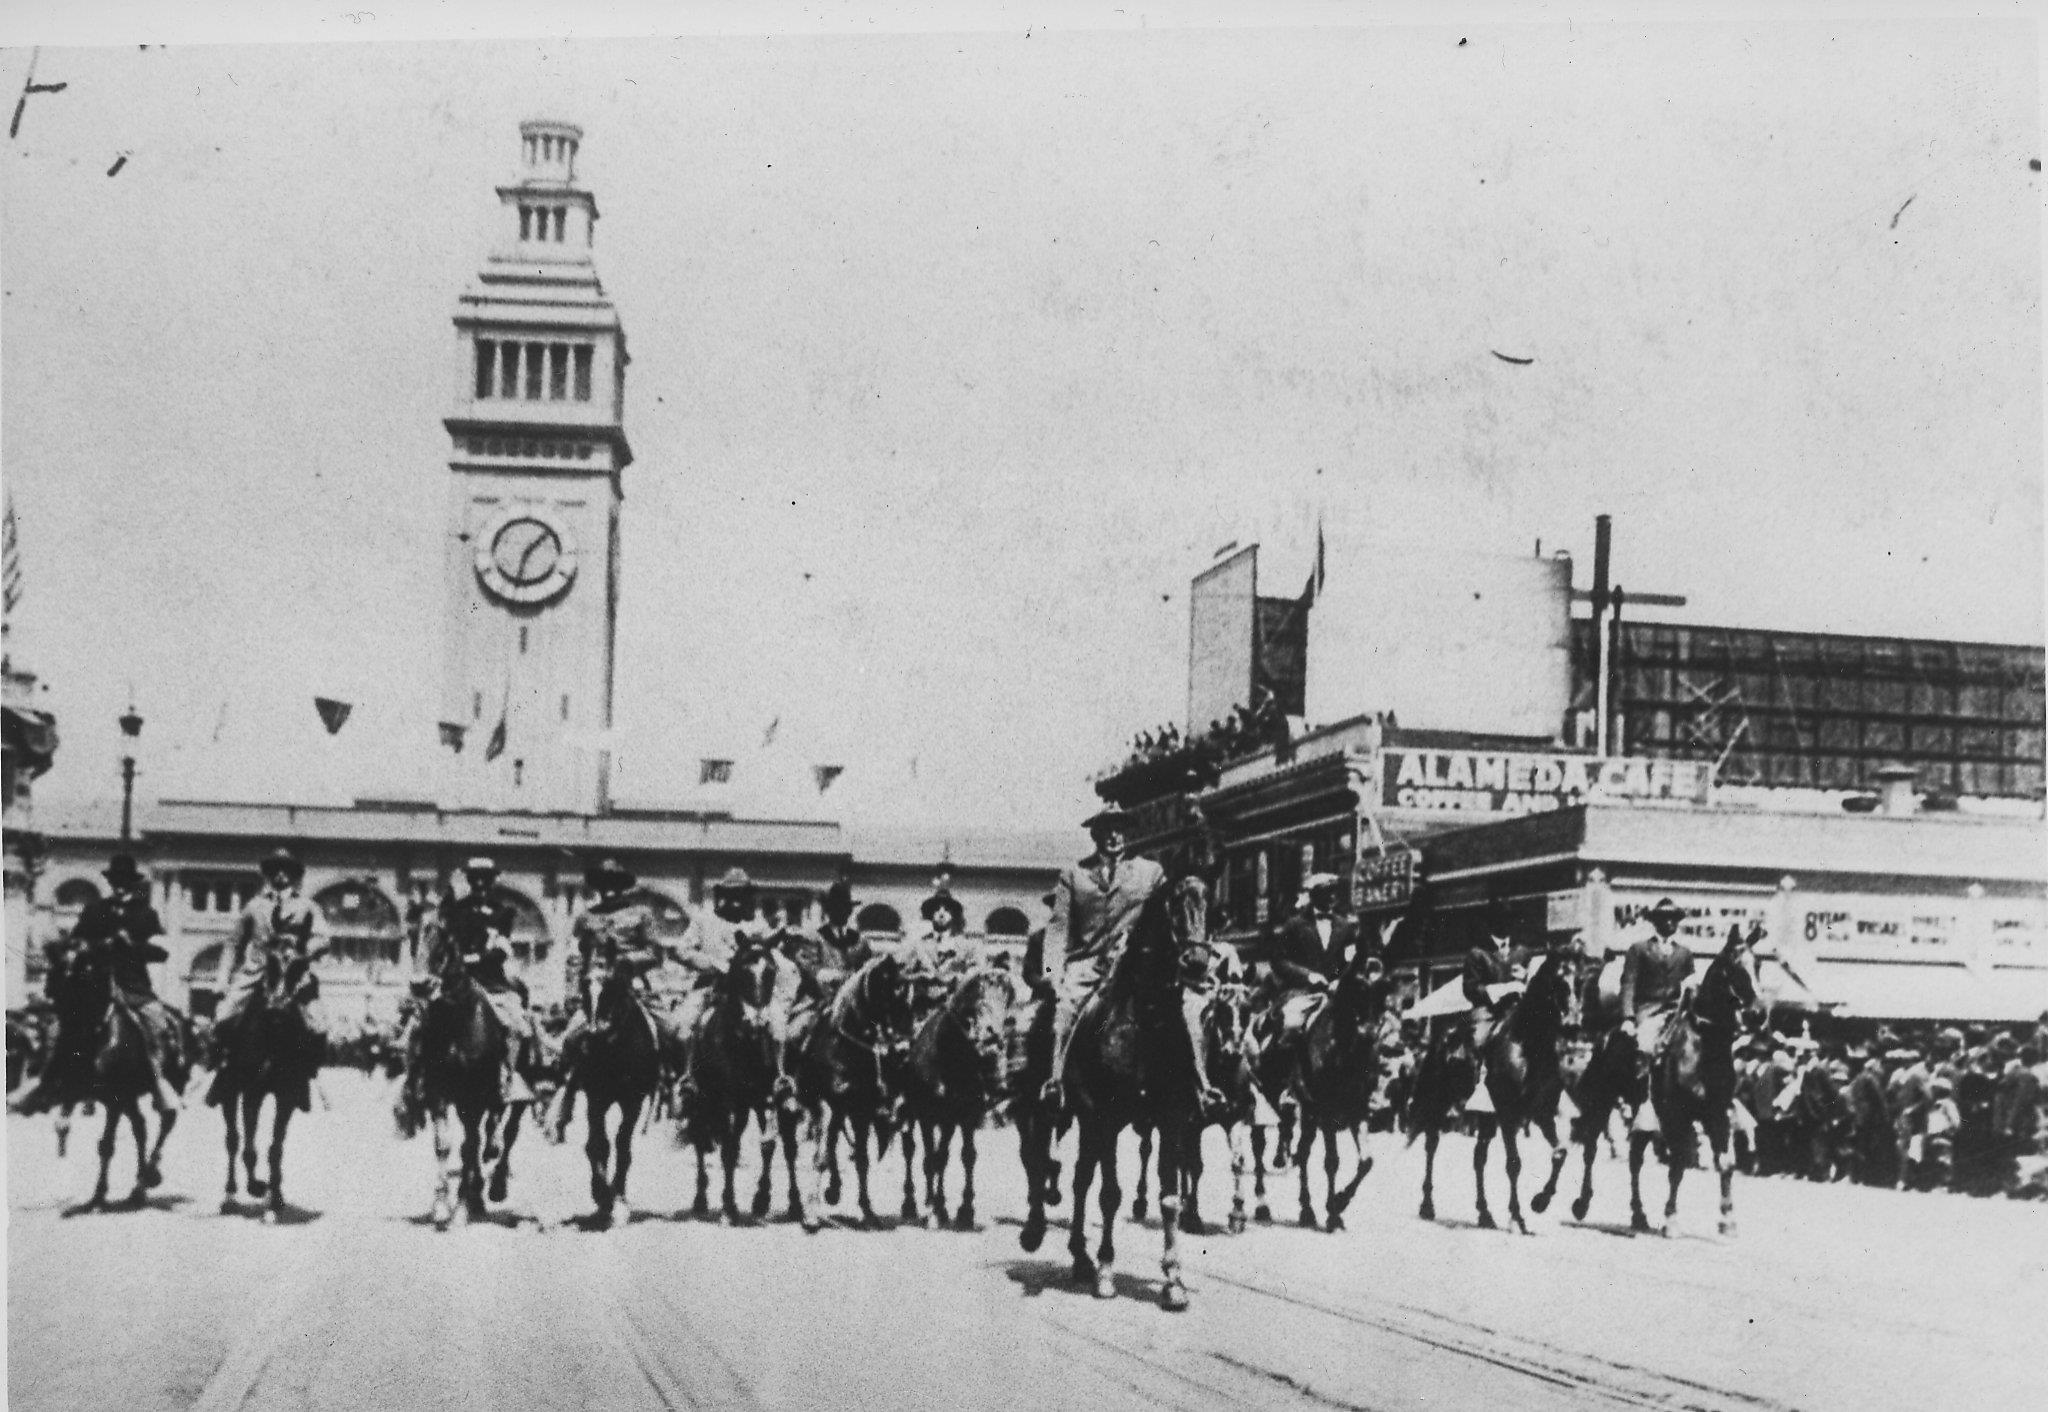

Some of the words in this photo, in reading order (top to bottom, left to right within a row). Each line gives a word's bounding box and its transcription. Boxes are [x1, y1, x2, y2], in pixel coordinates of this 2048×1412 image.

[1397, 753, 1588, 792] ALAMEDA
[1599, 757, 1697, 797] CAFE
[1502, 793, 1558, 813] AND
[1804, 911, 1818, 941] 8
